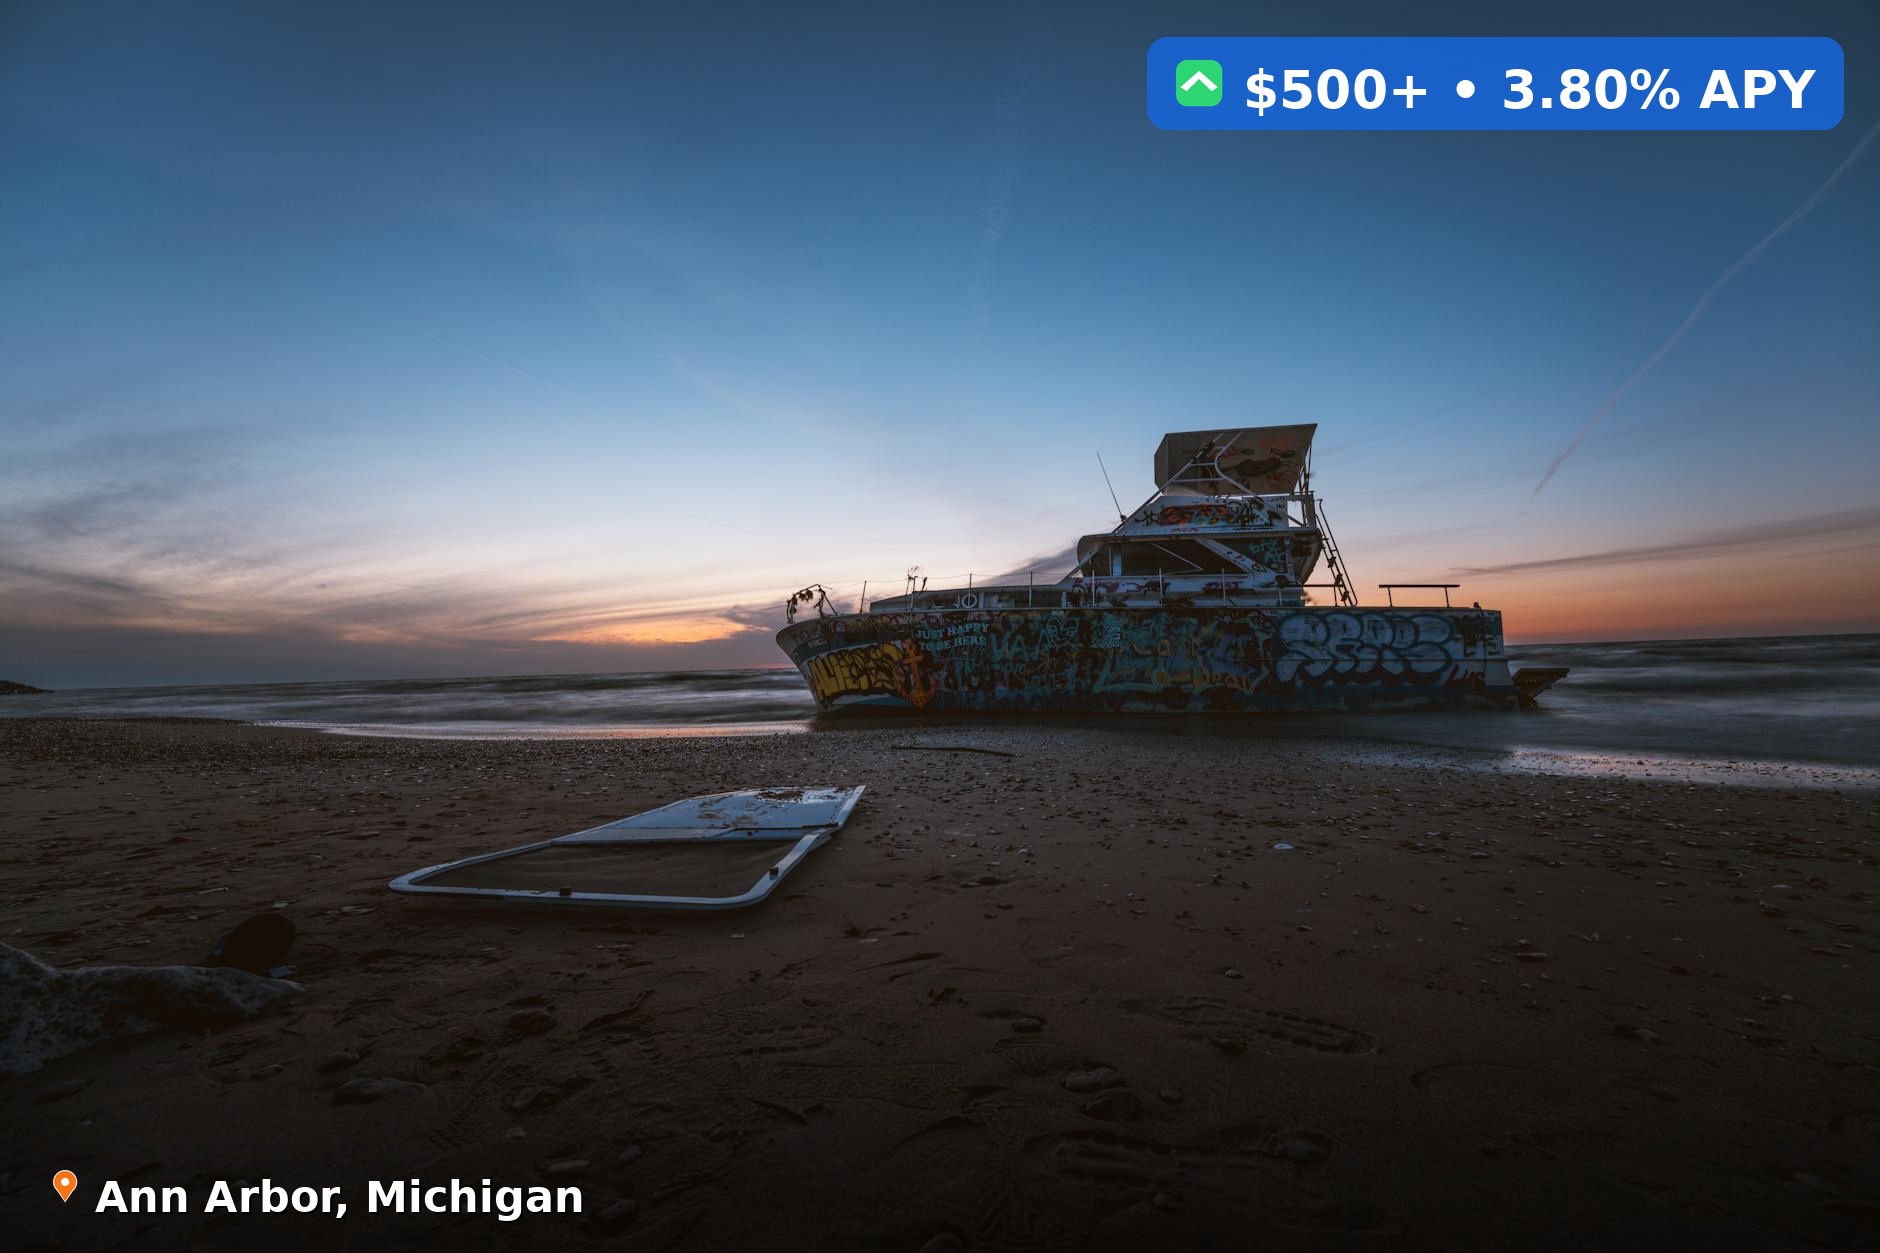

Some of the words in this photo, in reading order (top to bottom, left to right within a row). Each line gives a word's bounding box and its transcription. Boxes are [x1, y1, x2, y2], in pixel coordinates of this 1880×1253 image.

[915, 627, 944, 640] JUST
[946, 623, 990, 637] HAPPY
[936, 639, 952, 650] BE
[953, 635, 988, 648] HERE
